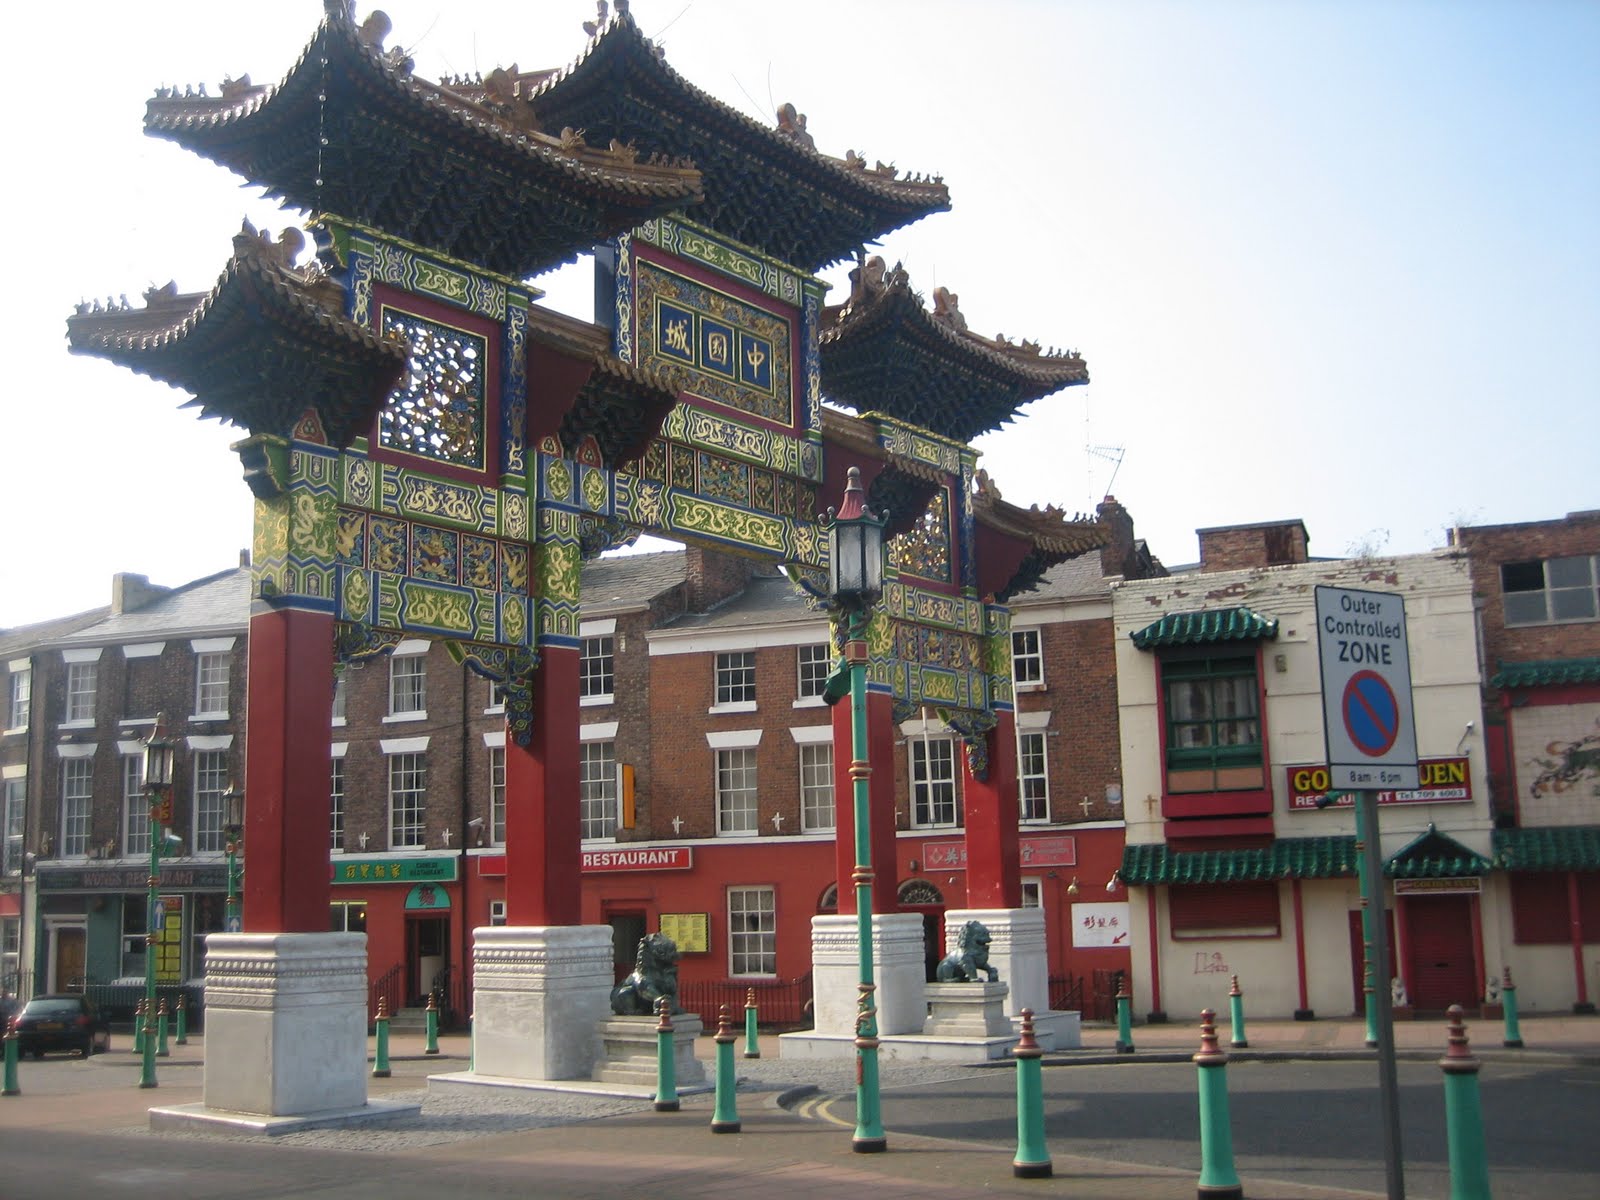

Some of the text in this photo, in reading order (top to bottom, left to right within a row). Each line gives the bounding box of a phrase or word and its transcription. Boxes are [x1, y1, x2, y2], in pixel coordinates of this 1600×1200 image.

[1341, 595, 1381, 614] Outer
[1325, 616, 1400, 639] Controlled
[1338, 641, 1392, 665] ZONE
[1294, 761, 1465, 792] GO UEN
[583, 850, 679, 867] RESTAURANT
